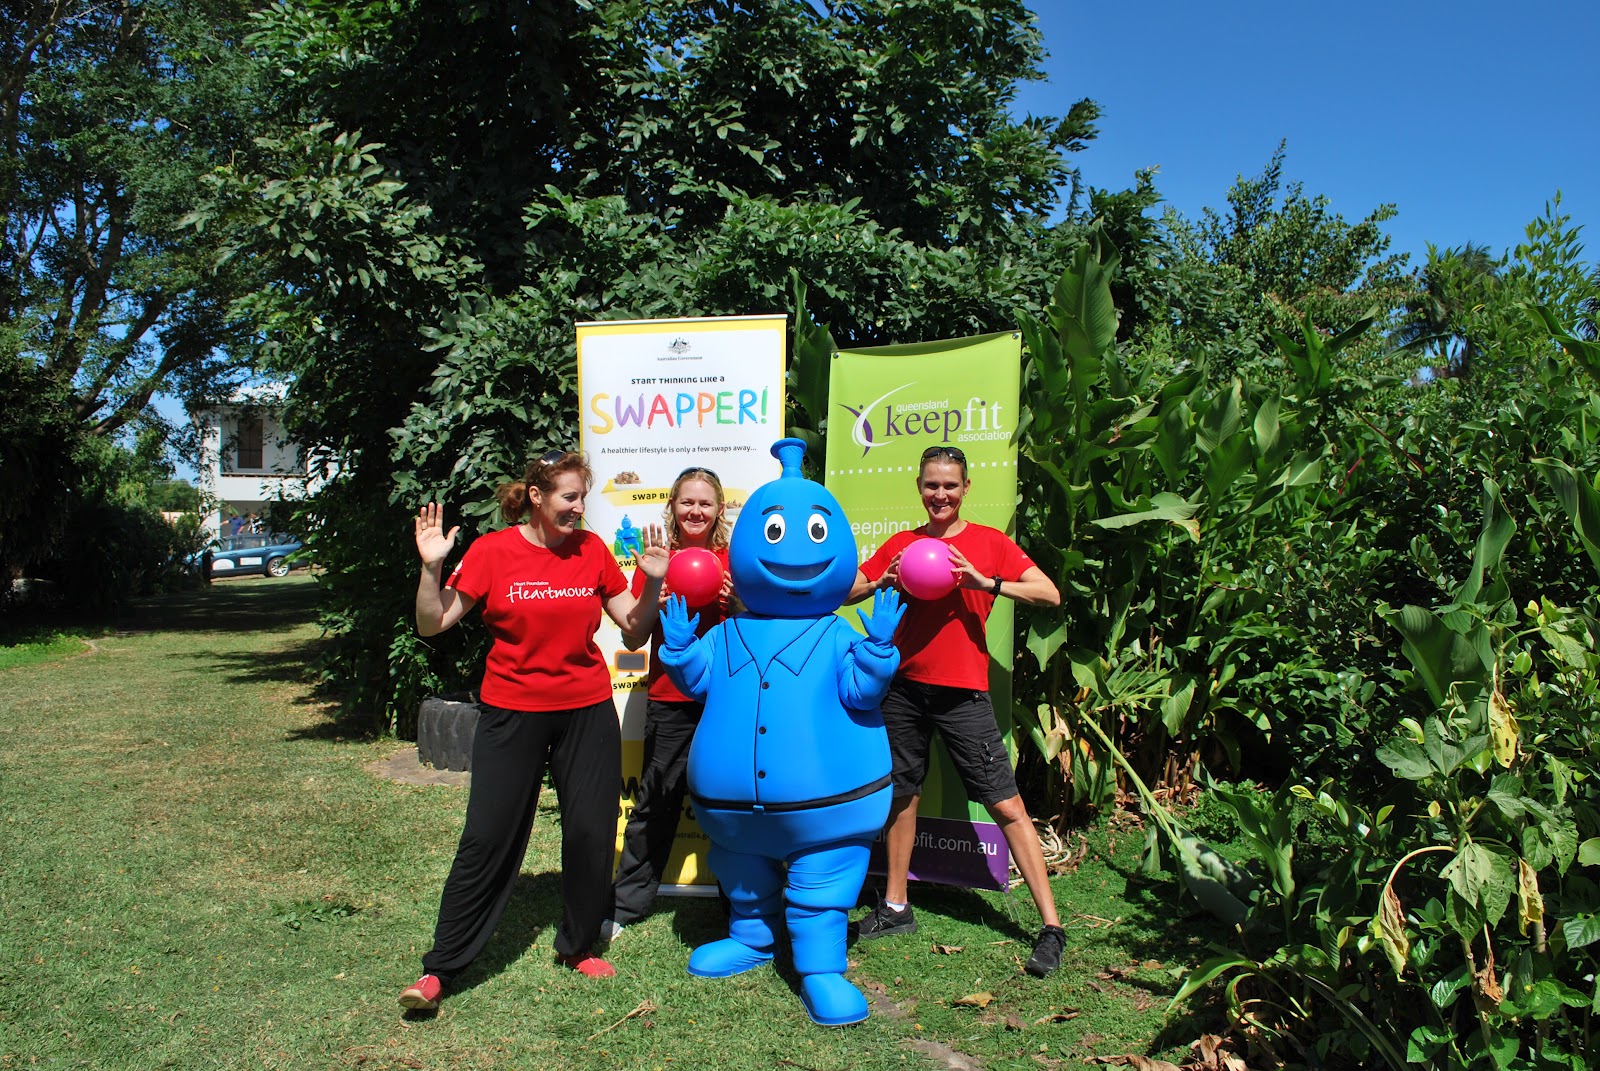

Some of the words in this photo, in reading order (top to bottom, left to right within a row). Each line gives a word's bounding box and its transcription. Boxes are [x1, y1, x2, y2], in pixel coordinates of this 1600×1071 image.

[589, 385, 768, 435] SWAPPER!
[896, 399, 949, 413] queensland
[957, 431, 1012, 443] association
[640, 446, 667, 455] lifestyle
[675, 446, 690, 454] only
[733, 445, 757, 453] away...
[659, 492, 669, 500] BI
[851, 517, 910, 539] eeping
[505, 585, 595, 603] Heartmoves
